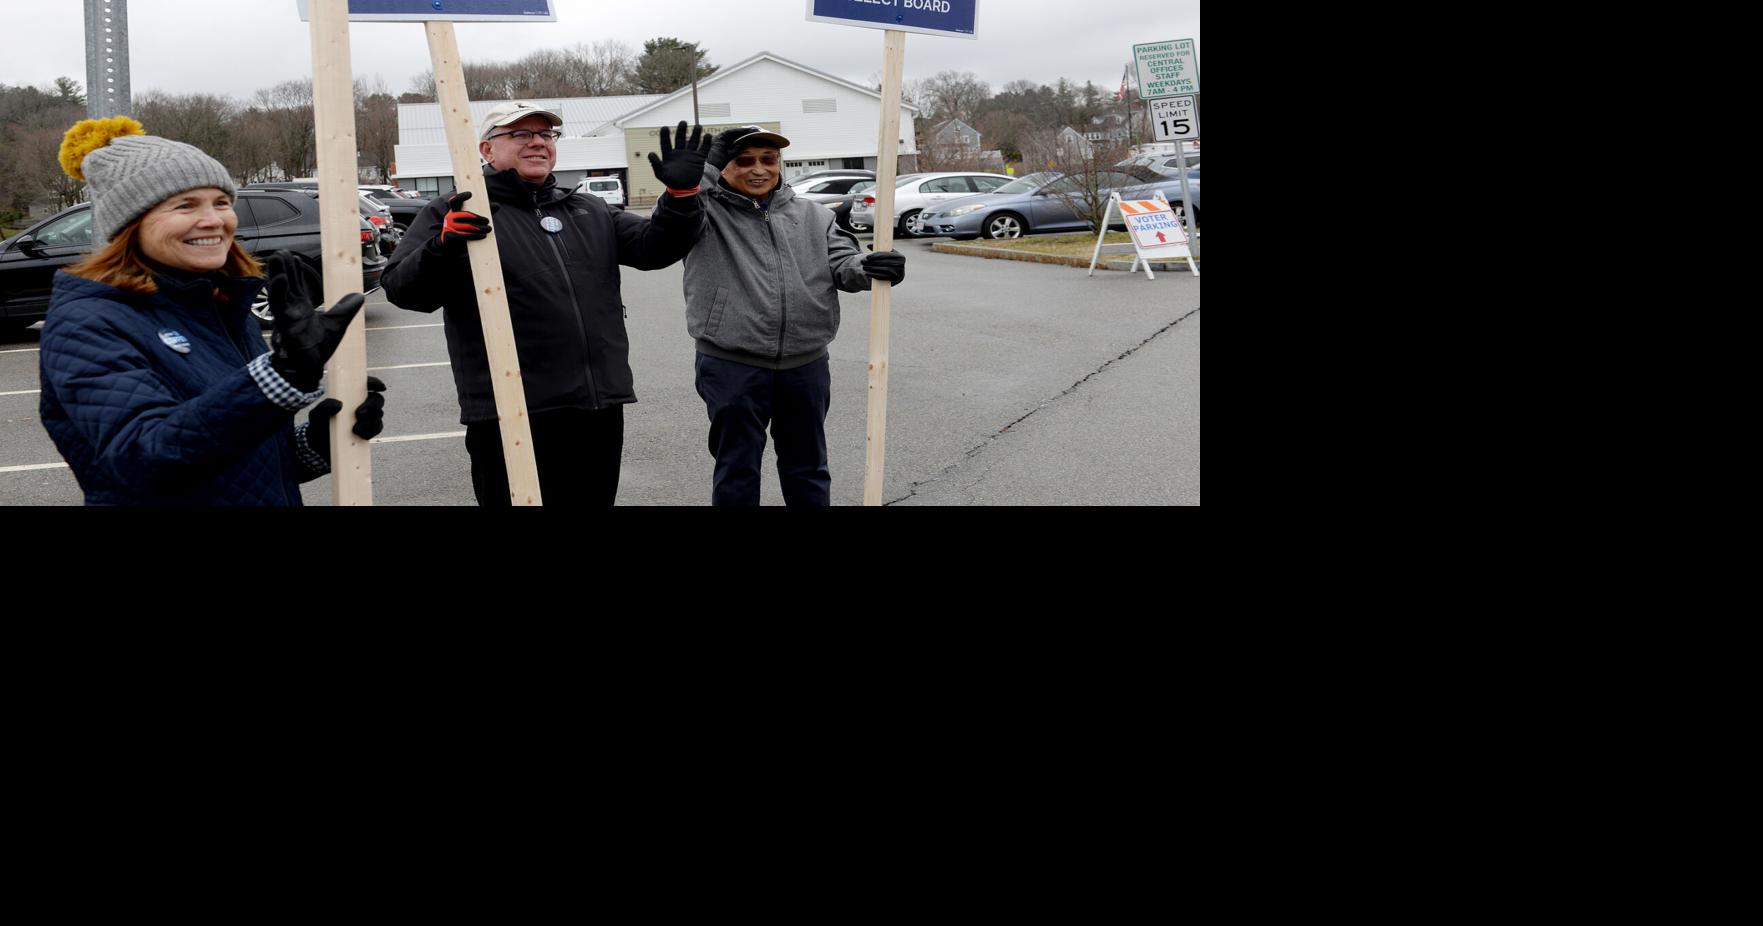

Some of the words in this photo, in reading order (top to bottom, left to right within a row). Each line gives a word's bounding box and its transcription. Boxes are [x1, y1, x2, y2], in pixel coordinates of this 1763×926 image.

[903, 0, 951, 13] BOARD
[1137, 44, 1173, 53] PARKING
[1140, 52, 1174, 60] RESERVED
[1148, 58, 1184, 67] CENTRAL
[1150, 65, 1184, 74] OFFICES
[1147, 78, 1192, 88] WEEKDAYS
[1154, 100, 1191, 110] SPEED
[1158, 110, 1188, 118] LIMIT
[1160, 118, 1190, 136] 15
[1134, 214, 1168, 223] VOTER
[1132, 220, 1178, 231] PARKING
